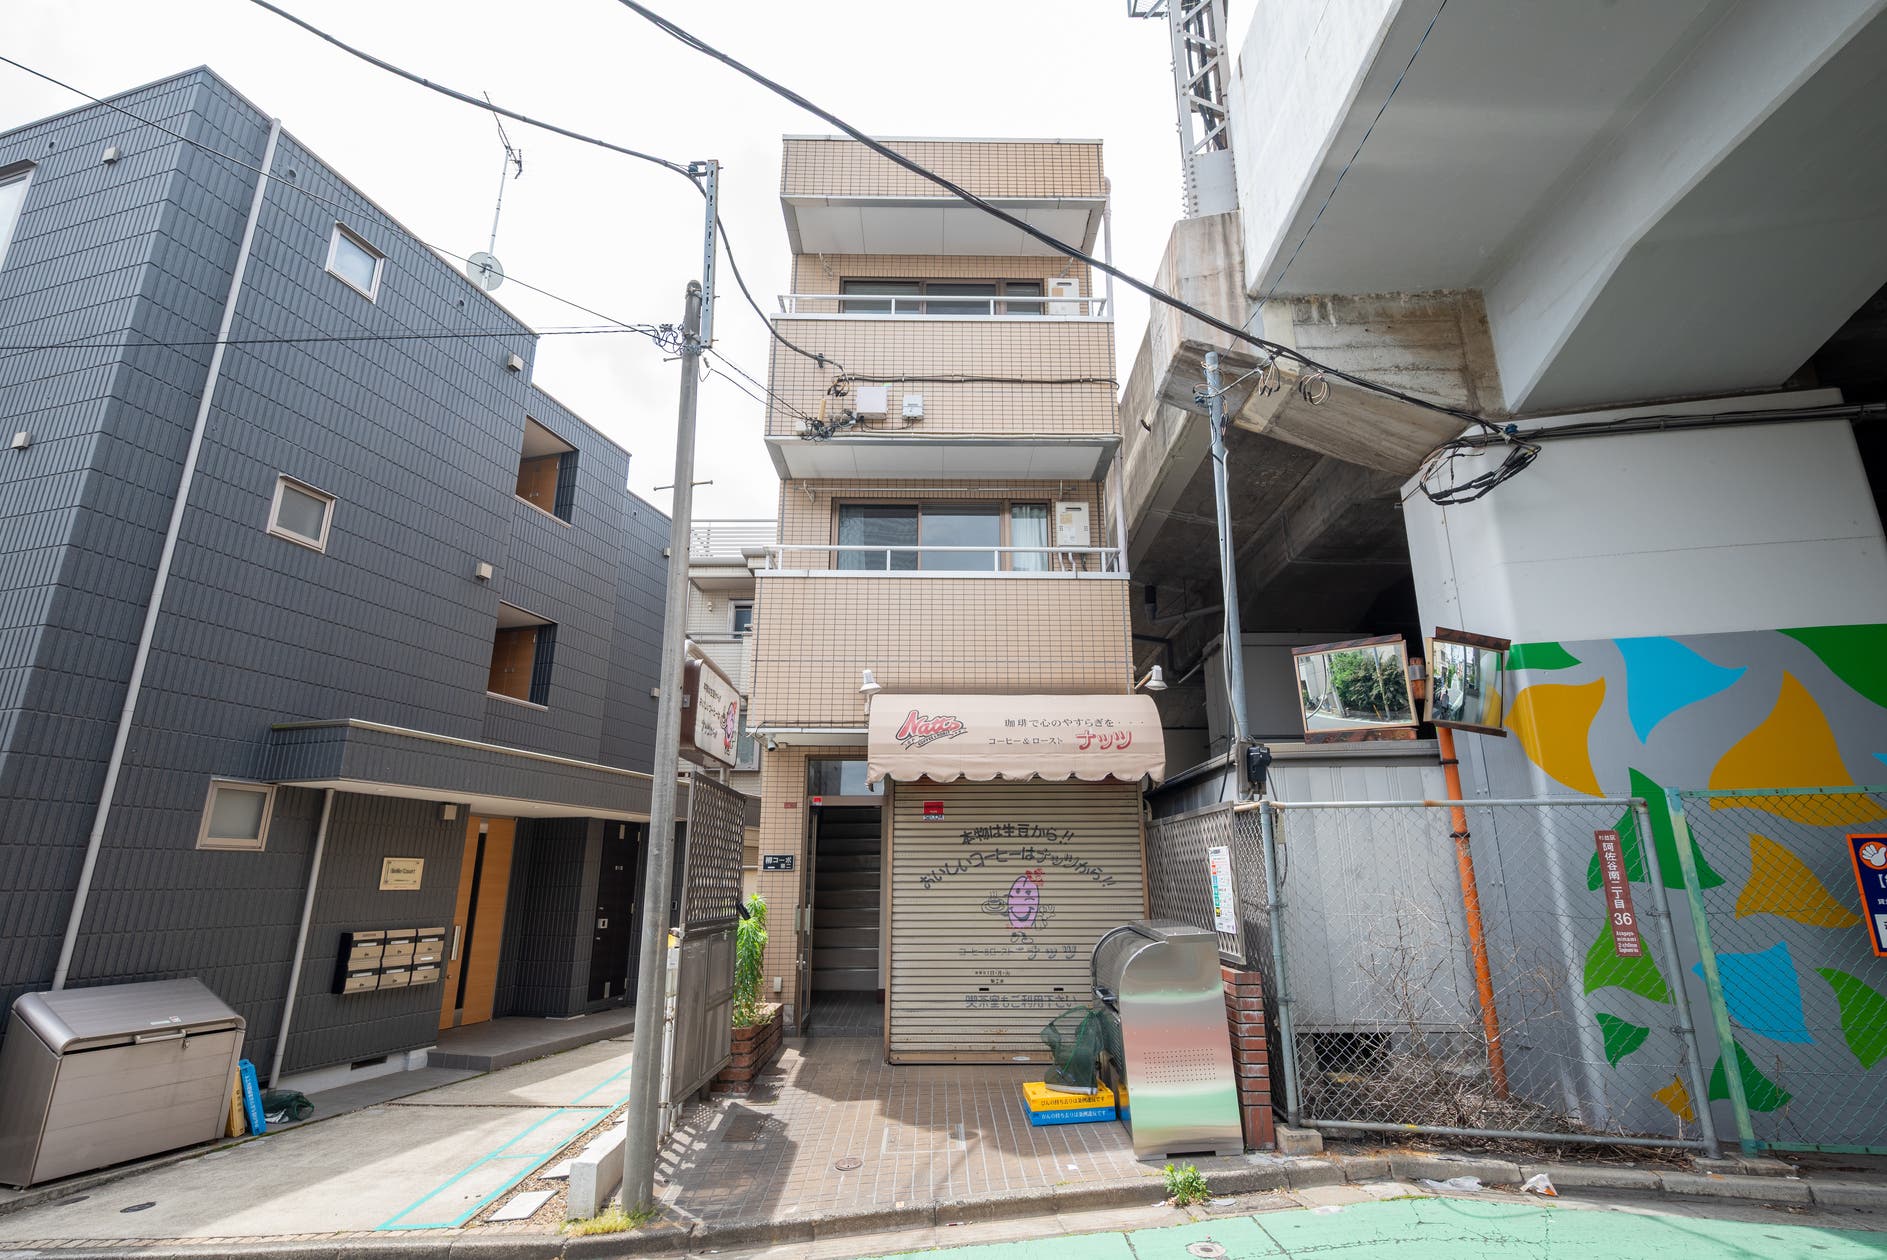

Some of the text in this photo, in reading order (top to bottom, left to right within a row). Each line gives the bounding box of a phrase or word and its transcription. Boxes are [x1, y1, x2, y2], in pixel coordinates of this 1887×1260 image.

[1075, 729, 1133, 751] ナッツ
[1602, 842, 1625, 909] 阿佐谷南二丁目
[1614, 912, 1633, 926] 36
